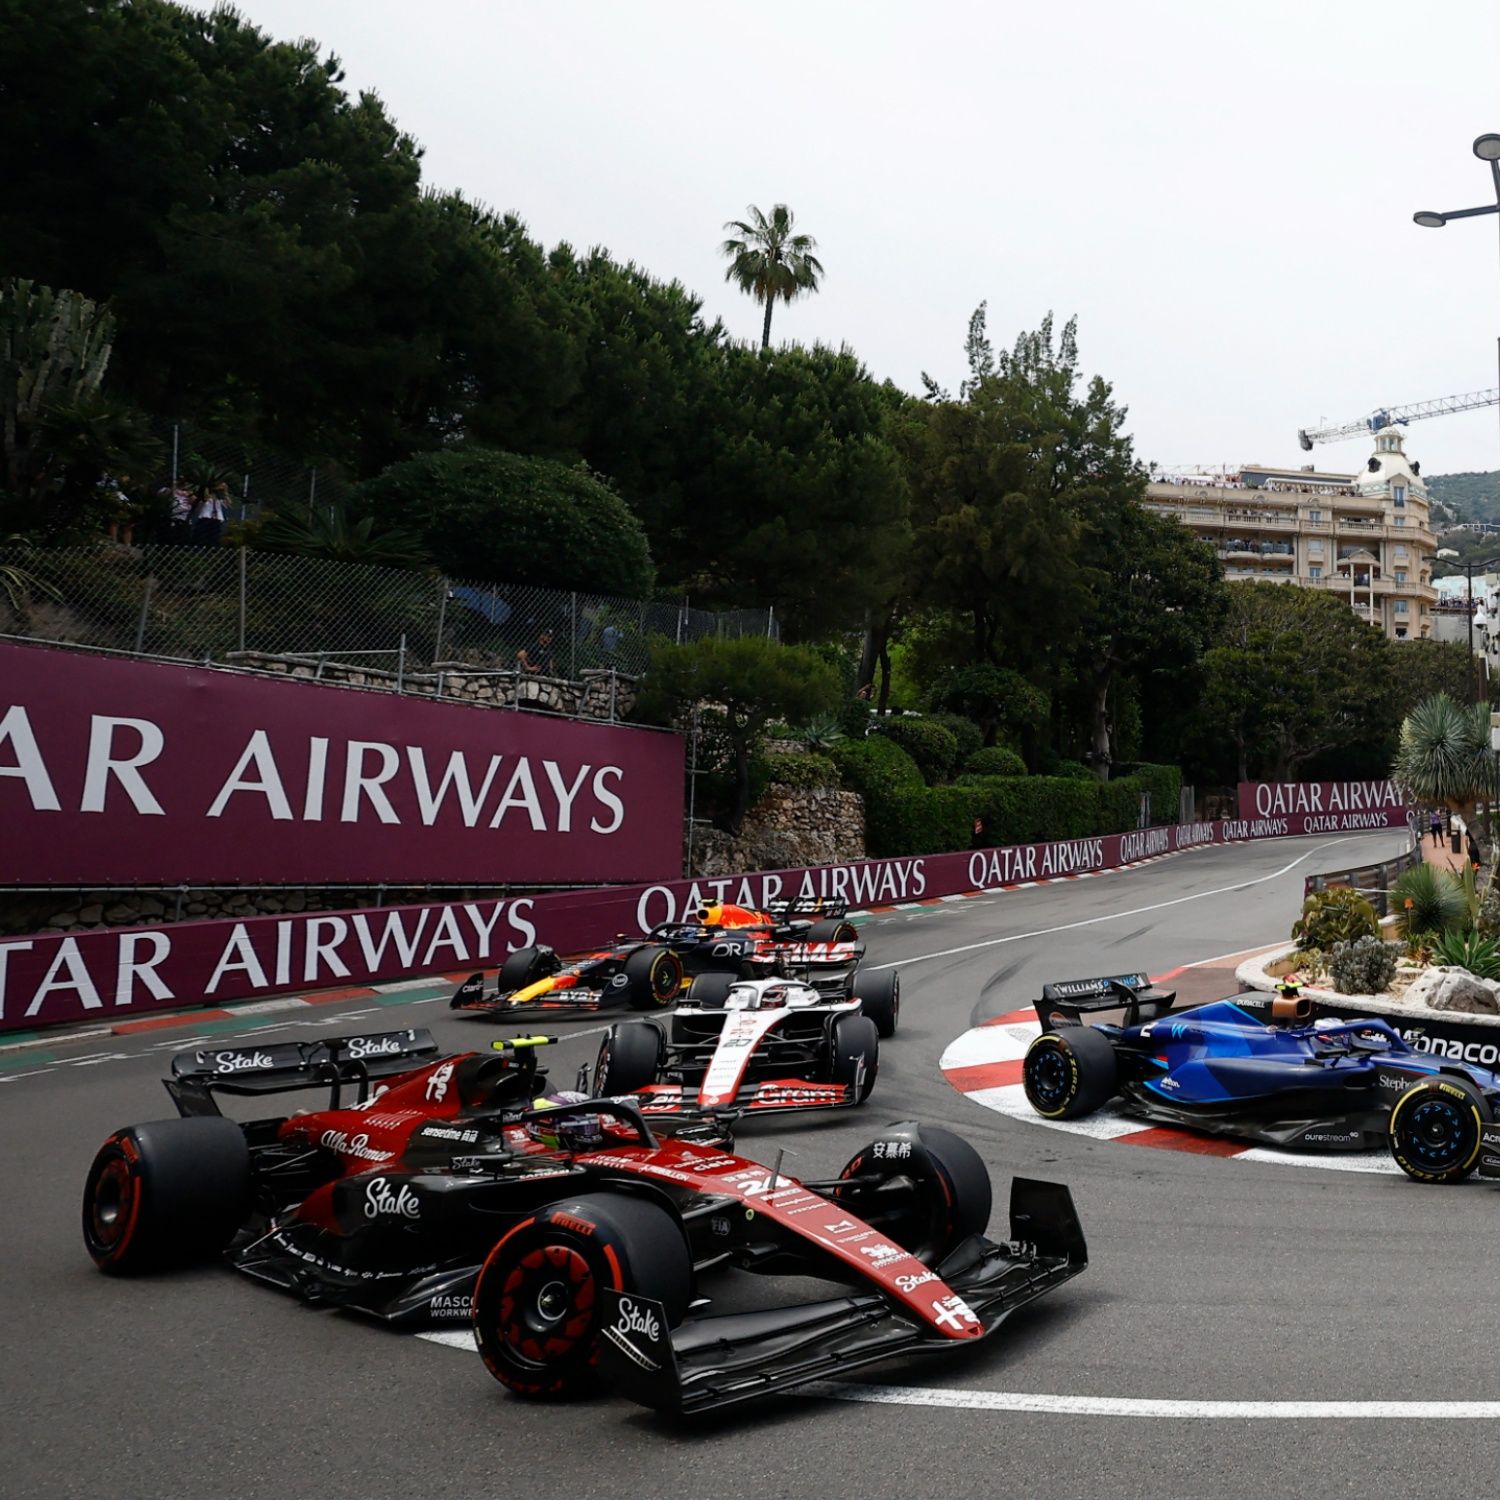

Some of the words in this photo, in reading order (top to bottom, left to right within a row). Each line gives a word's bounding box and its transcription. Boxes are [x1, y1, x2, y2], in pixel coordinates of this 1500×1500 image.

[205, 730, 624, 834] AIRWAYS
[1256, 783, 1323, 818] QATAR
[1222, 820, 1249, 841] QATAR
[1250, 817, 1288, 837] AIRWAYS
[1304, 815, 1339, 833] QATAR
[1341, 812, 1388, 829] AIRWAYS
[1120, 831, 1145, 863] QATAR
[969, 845, 1036, 889] QATAR
[1041, 839, 1103, 876] AIRWAYS
[637, 874, 783, 935] QATAR
[800, 859, 926, 904] AIRWAYS
[204, 898, 537, 994] AIRWAYS
[1060, 979, 1104, 994] WILLIAMS
[348, 1037, 401, 1059] Stake
[215, 1051, 275, 1074] Stake
[757, 1084, 836, 1104] Gram
[1439, 1083, 1466, 1100] PIRELLI
[321, 1130, 349, 1153] Alfa
[348, 1133, 395, 1162] Romeo
[421, 1127, 462, 1141] sensetime
[873, 1141, 912, 1158] 安慕希
[363, 1176, 421, 1219] Stake
[736, 1174, 794, 1197] 24
[551, 1211, 597, 1236] PIRELLI
[617, 1297, 660, 1342] Stake
